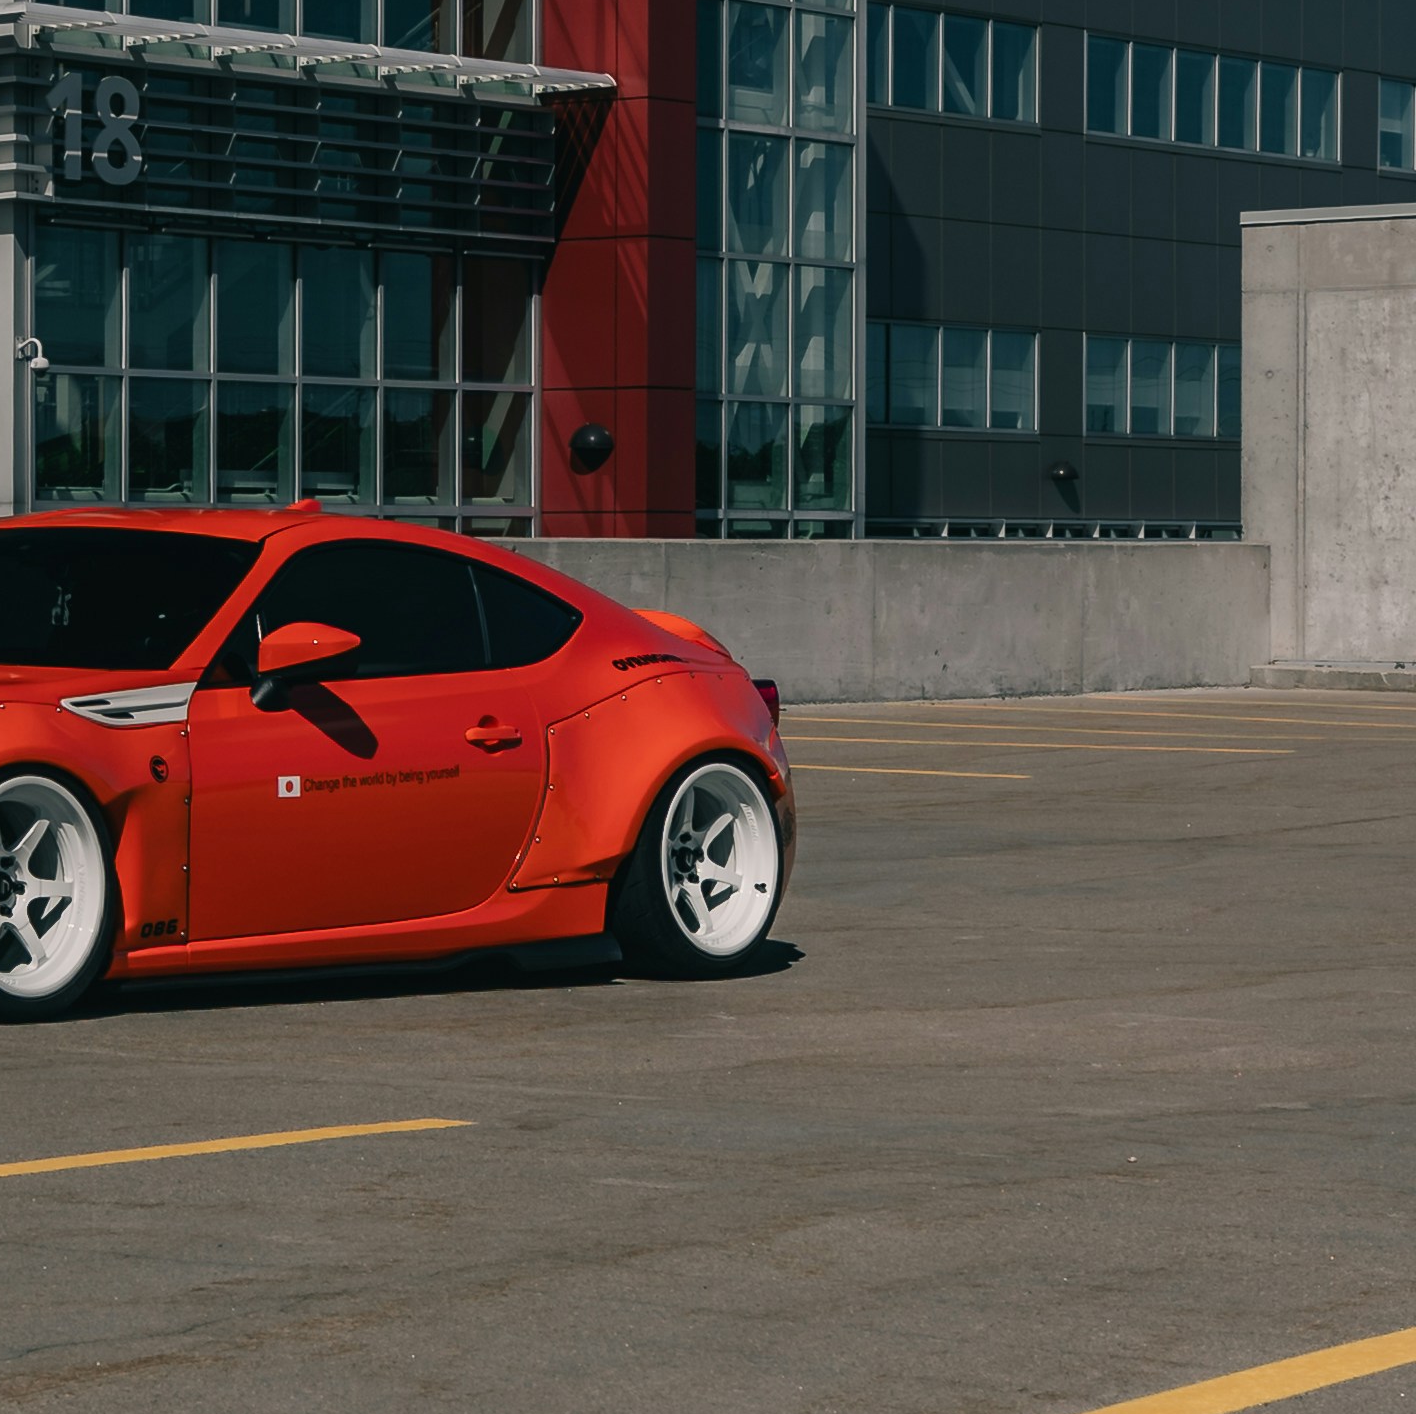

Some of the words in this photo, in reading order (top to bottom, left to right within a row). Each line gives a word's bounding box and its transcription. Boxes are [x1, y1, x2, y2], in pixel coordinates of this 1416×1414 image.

[46, 73, 142, 185] 18
[303, 778, 340, 793] Change
[342, 775, 357, 787] the
[359, 773, 384, 787] world
[386, 771, 397, 786] by
[399, 769, 424, 784] being
[426, 765, 460, 783] yourself
[140, 918, 179, 938] 086
